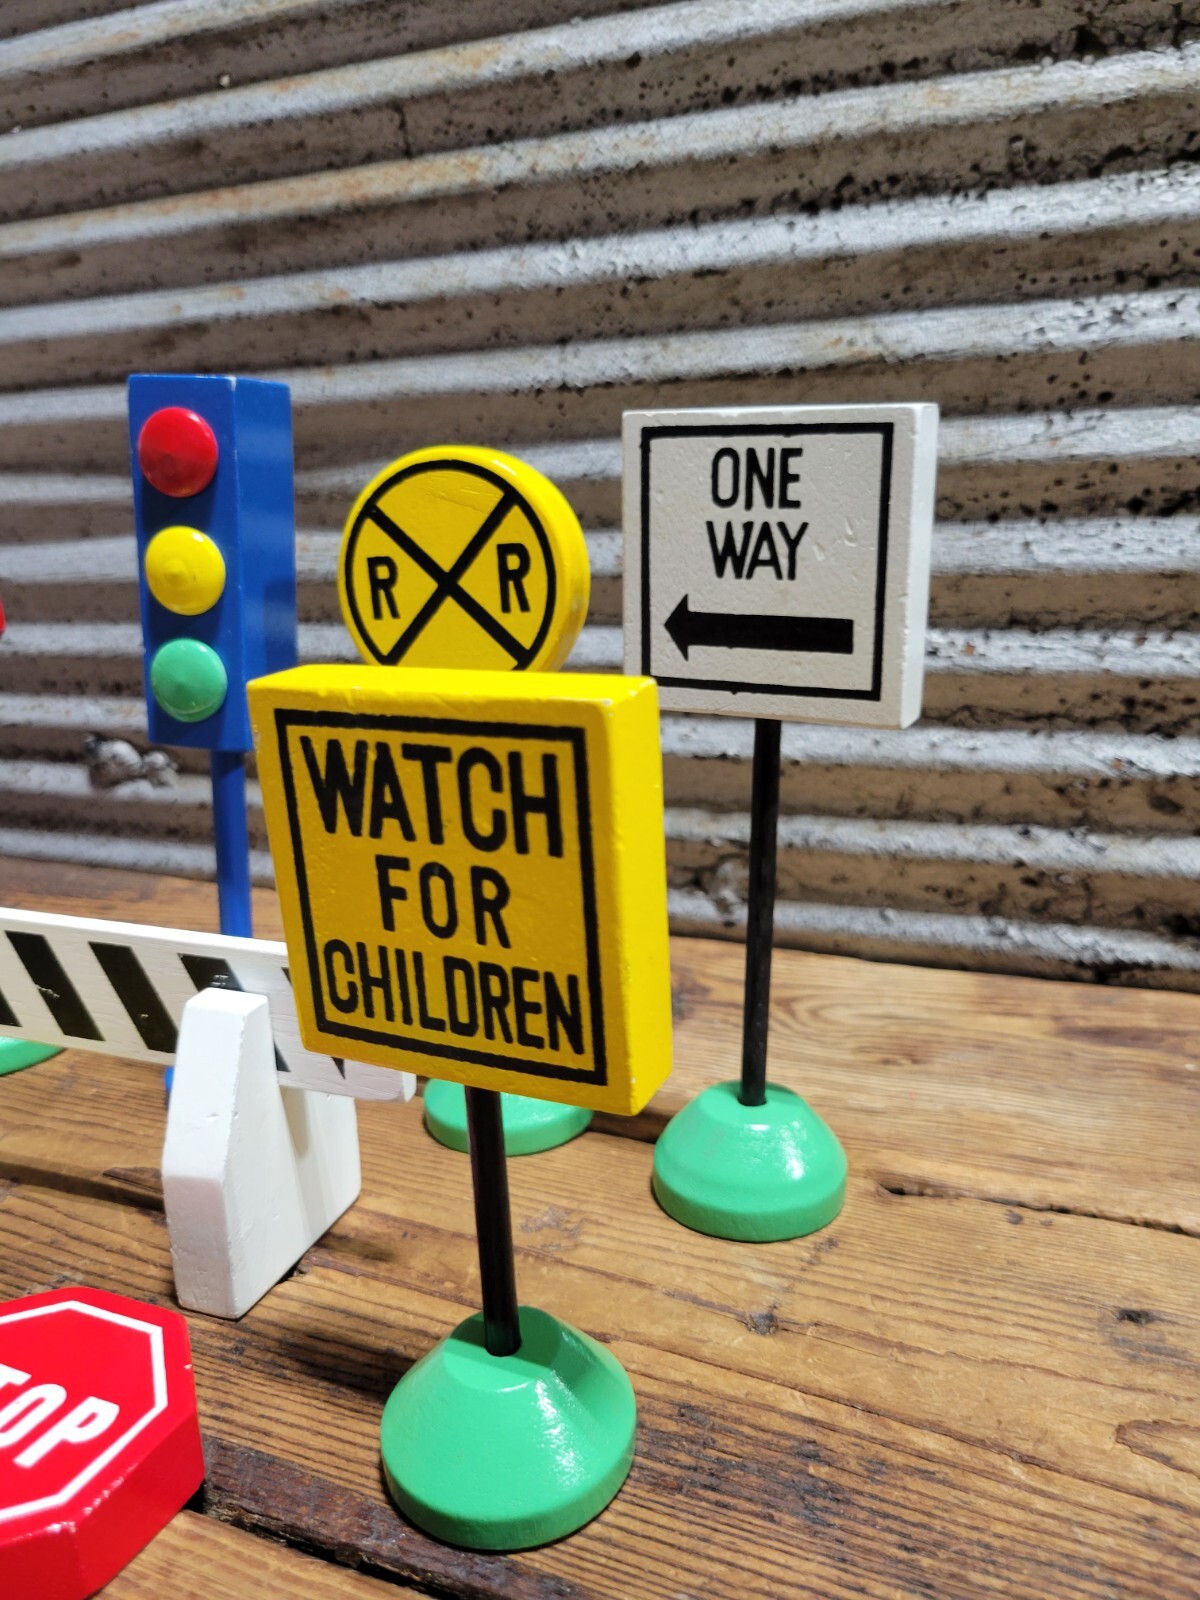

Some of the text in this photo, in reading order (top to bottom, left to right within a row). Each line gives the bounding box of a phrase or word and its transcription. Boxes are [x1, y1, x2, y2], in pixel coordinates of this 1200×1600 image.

[711, 447, 803, 511] ONE
[367, 543, 531, 620] R R
[706, 521, 809, 580] WAY
[299, 735, 564, 858] WATCH
[375, 854, 511, 949] FOR
[323, 939, 585, 1055] CHILDREN
